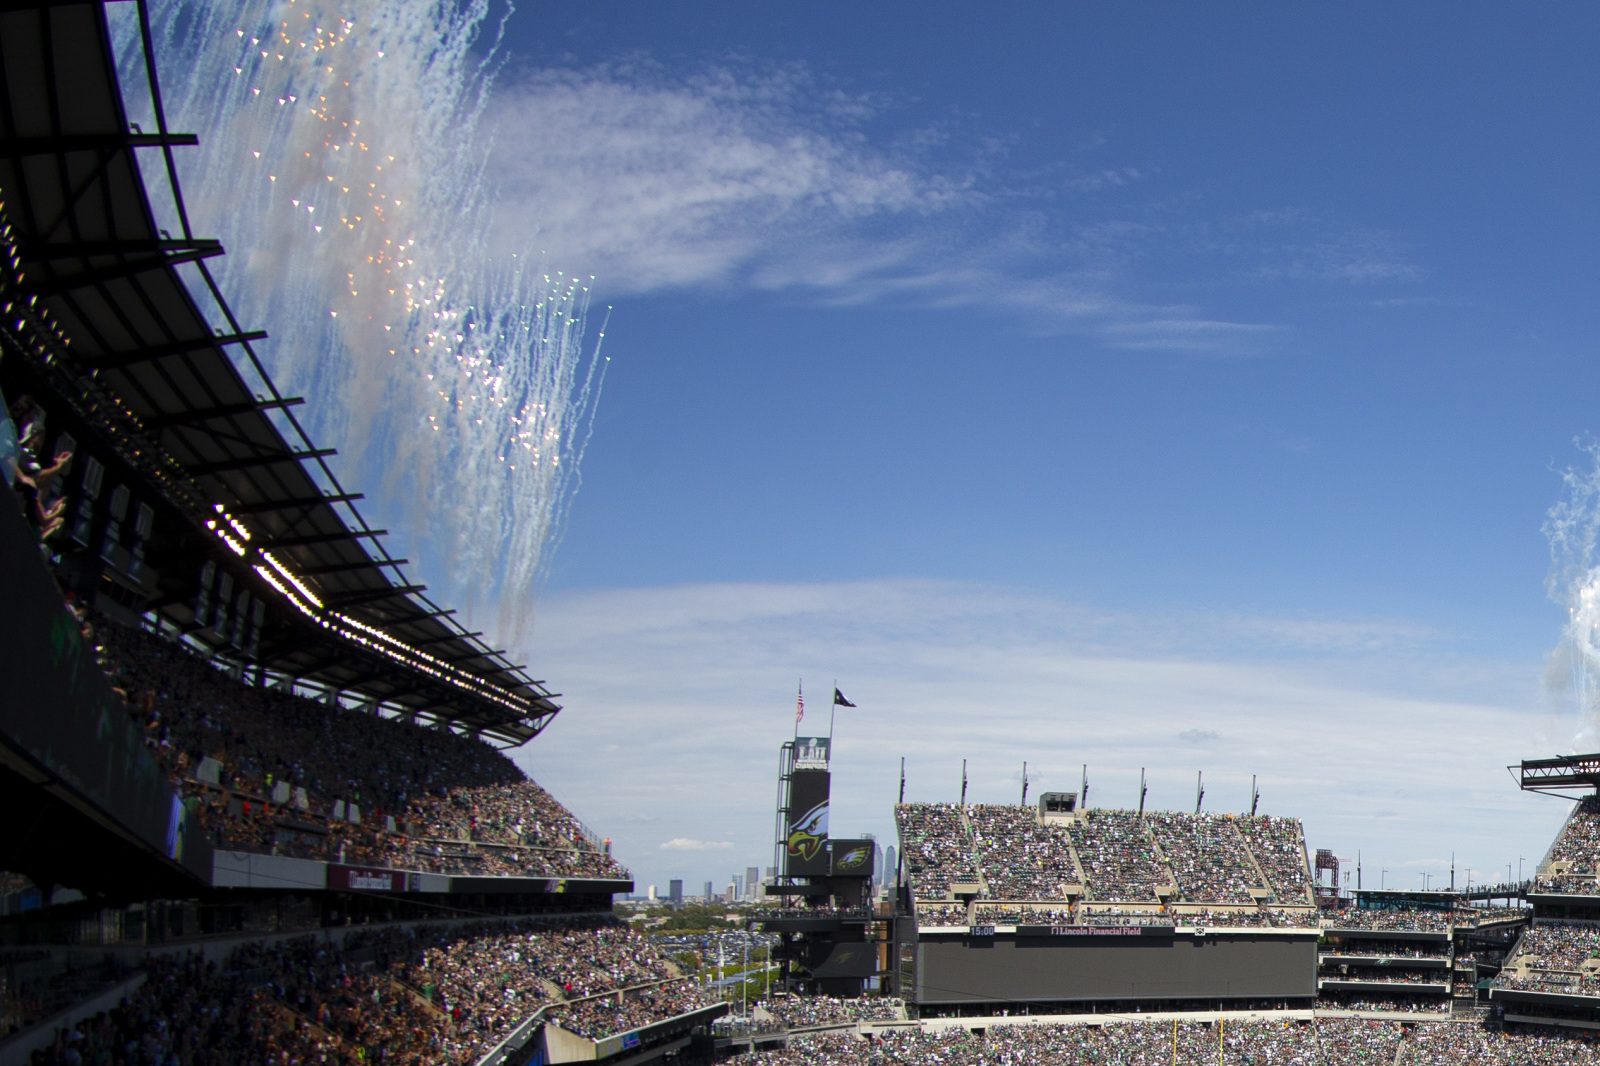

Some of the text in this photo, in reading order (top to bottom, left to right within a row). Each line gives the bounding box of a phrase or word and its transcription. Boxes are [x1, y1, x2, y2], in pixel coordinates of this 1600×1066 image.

[970, 926, 994, 936] 15:00
[1060, 926, 1141, 935] Lincoln Financial Field
